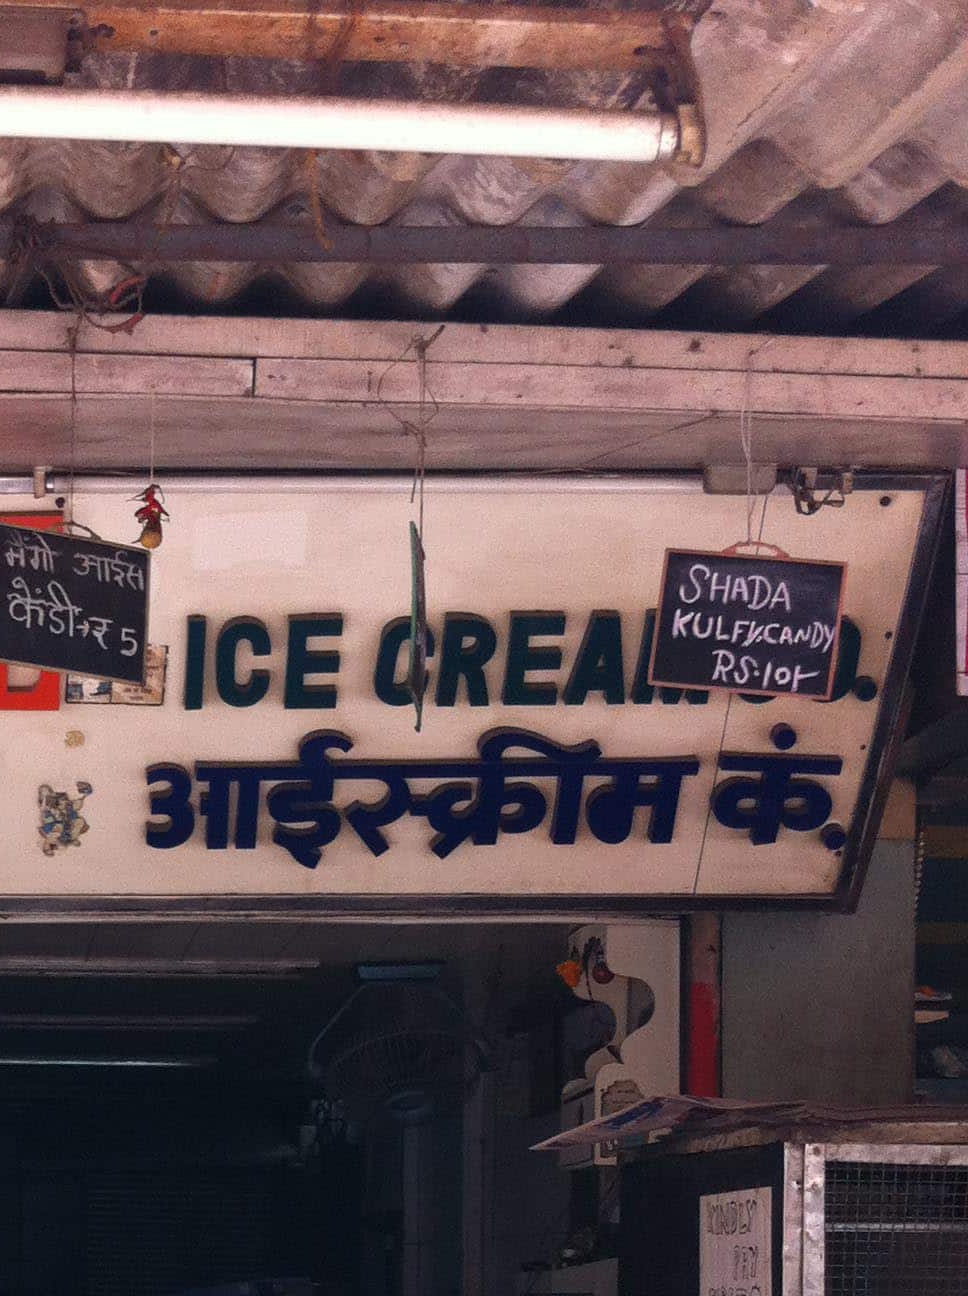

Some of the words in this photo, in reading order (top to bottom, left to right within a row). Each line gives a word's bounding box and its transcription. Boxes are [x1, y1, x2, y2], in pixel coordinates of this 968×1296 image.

[679, 563, 791, 612] SHADA
[184, 610, 344, 709] ICE
[145, 726, 699, 869] आईस्क्रीम
